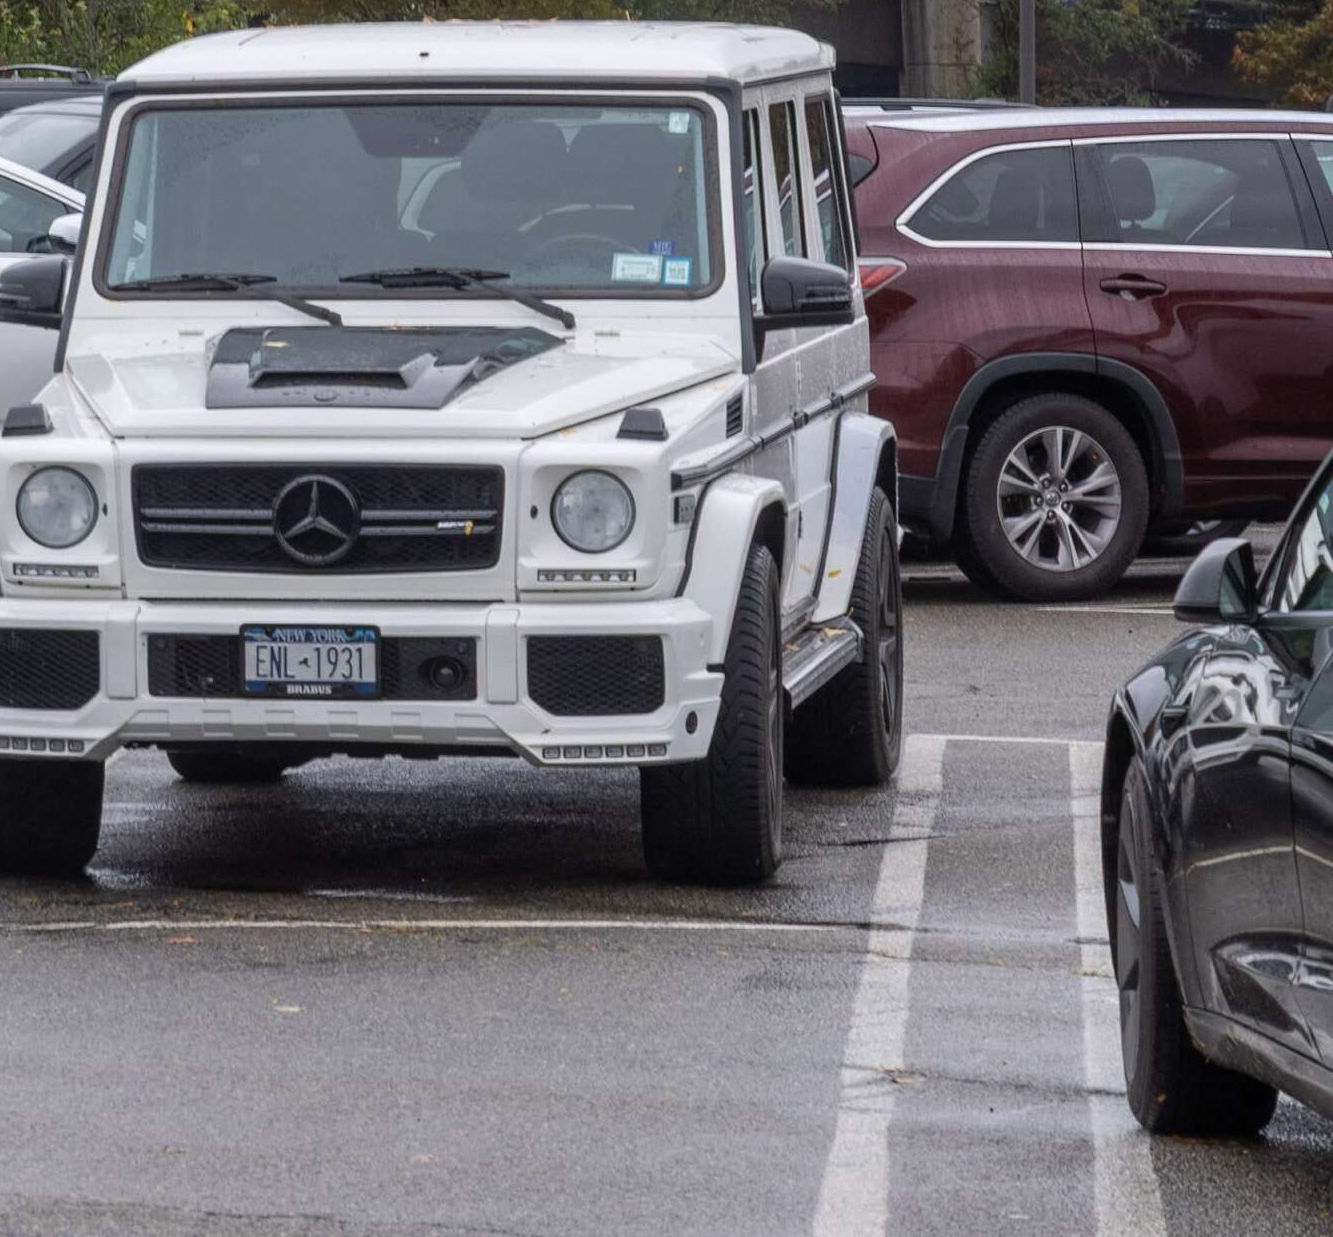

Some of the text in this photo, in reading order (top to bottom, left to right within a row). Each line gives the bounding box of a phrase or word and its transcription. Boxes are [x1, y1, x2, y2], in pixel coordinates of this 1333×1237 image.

[273, 627, 346, 643] NEW YORK
[256, 645, 364, 680] ENL 1931
[286, 683, 333, 696] BRABUS
